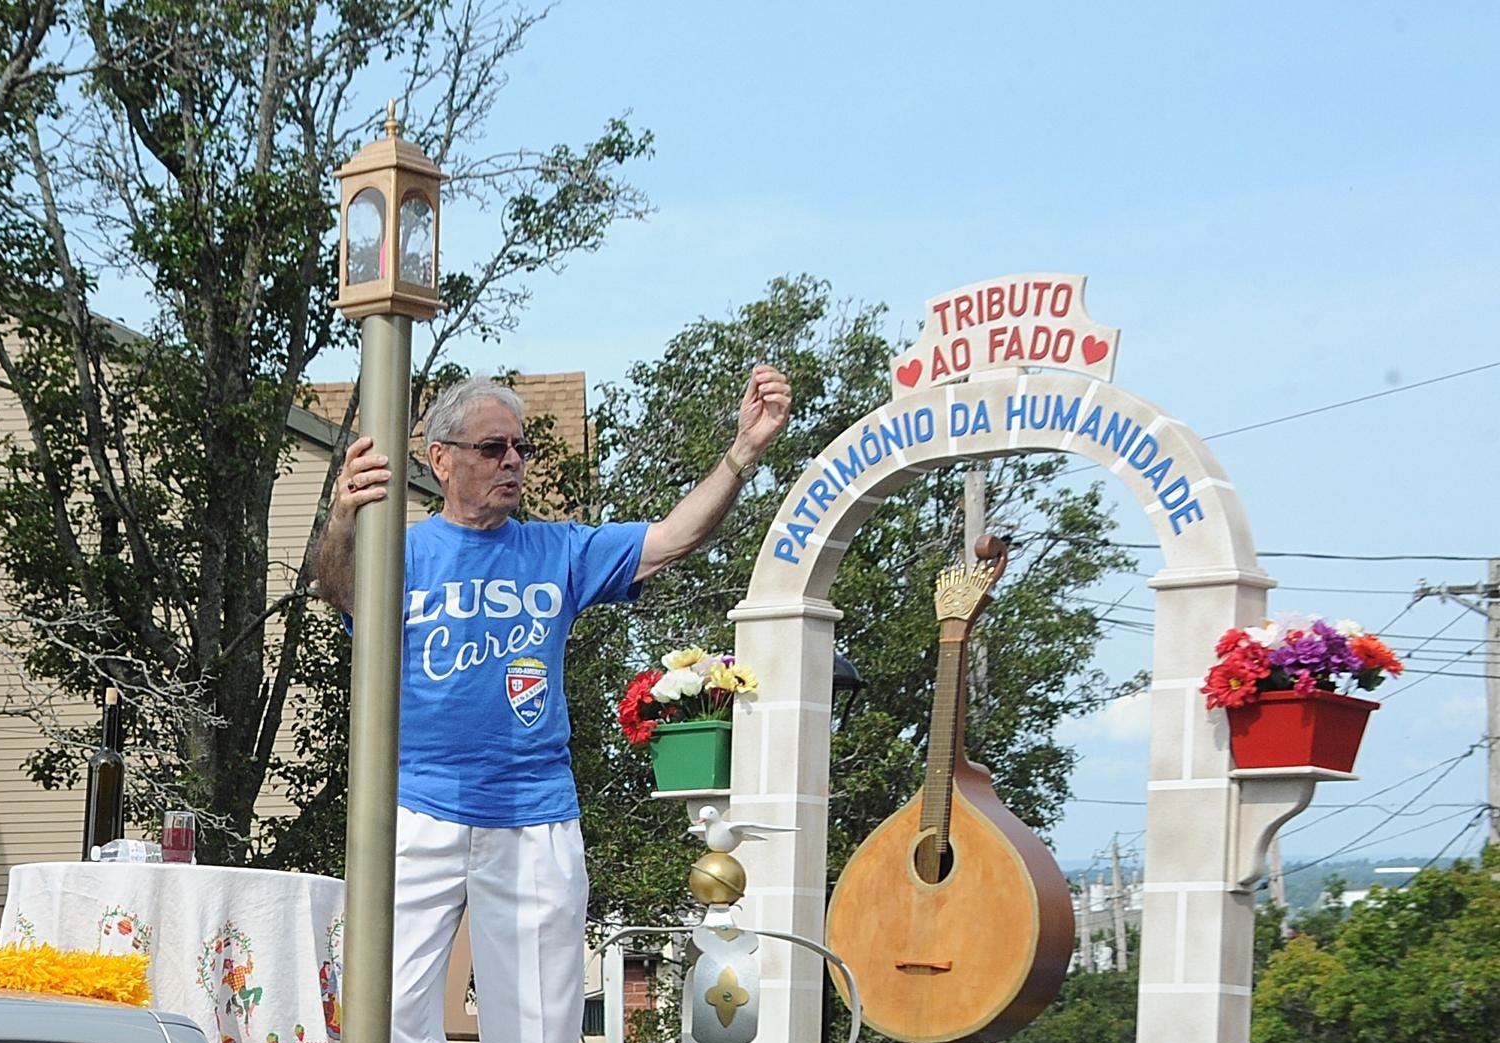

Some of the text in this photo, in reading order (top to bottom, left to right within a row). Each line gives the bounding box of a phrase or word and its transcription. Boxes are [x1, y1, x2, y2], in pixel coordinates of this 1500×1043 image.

[931, 281, 1073, 336] TRIBUTO
[930, 325, 1075, 382] AO FADO
[773, 394, 1206, 566] PATRIMÓNIO DA HUMANIDADE
[406, 578, 563, 625] LUSO
[423, 618, 550, 681] Cares
